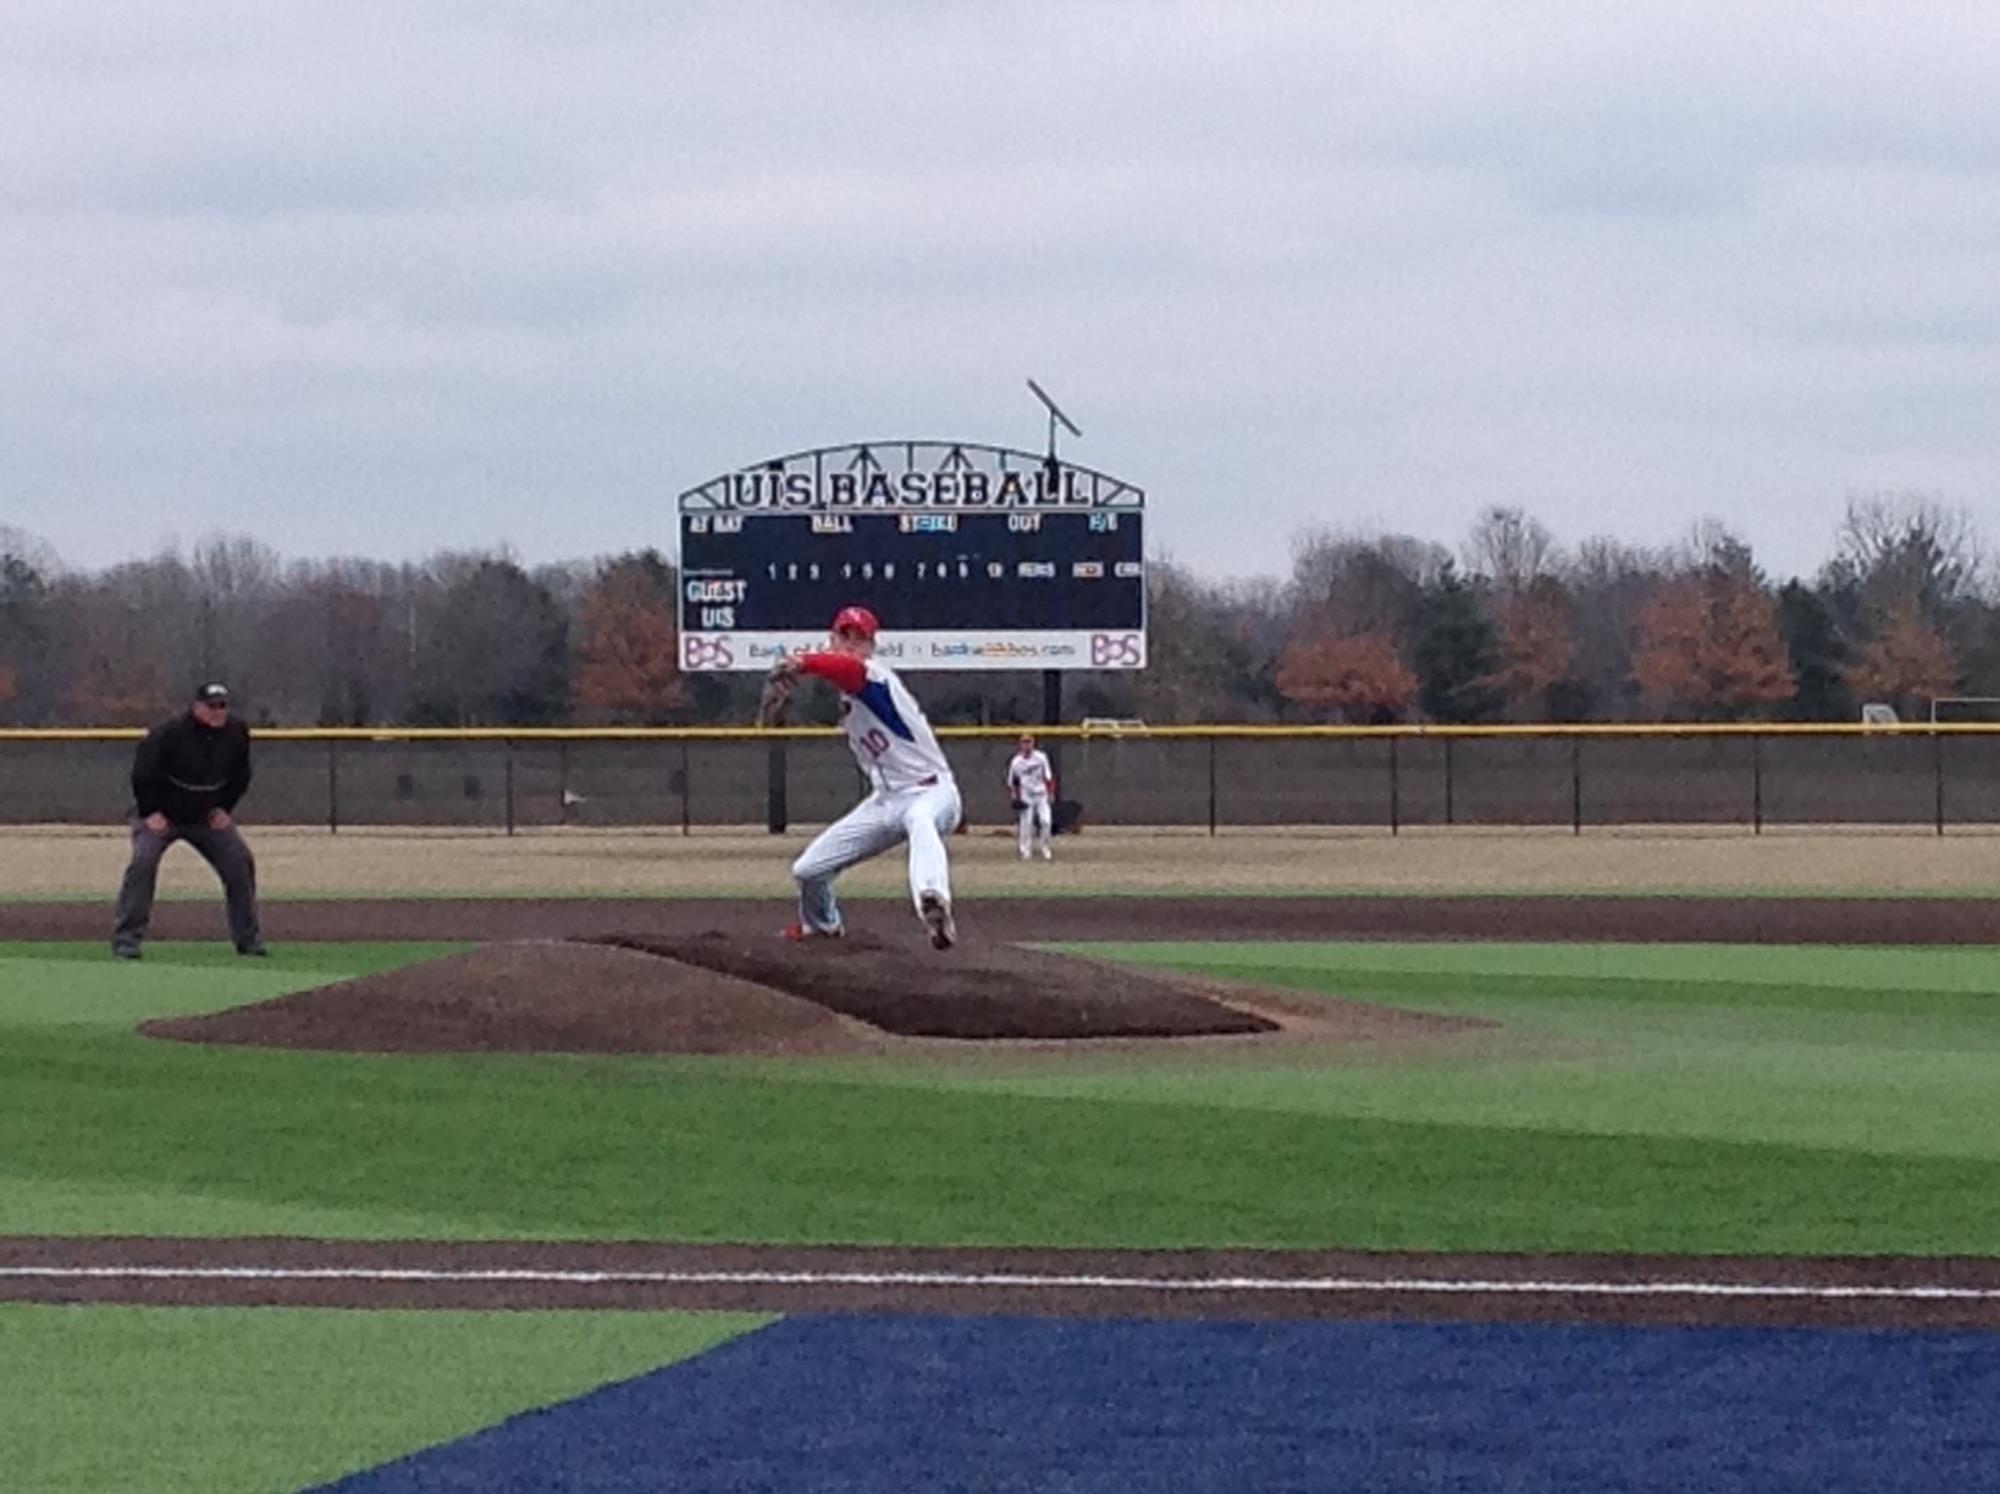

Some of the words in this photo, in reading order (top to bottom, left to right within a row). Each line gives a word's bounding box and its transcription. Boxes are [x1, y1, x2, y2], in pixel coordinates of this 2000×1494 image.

[734, 473, 813, 507] UIS
[829, 471, 1091, 506] BASEBALL
[811, 515, 853, 533] BALL
[1008, 513, 1041, 532] OUT
[686, 579, 747, 602] GUEST
[703, 607, 735, 628] UIS
[860, 727, 890, 758] 10
